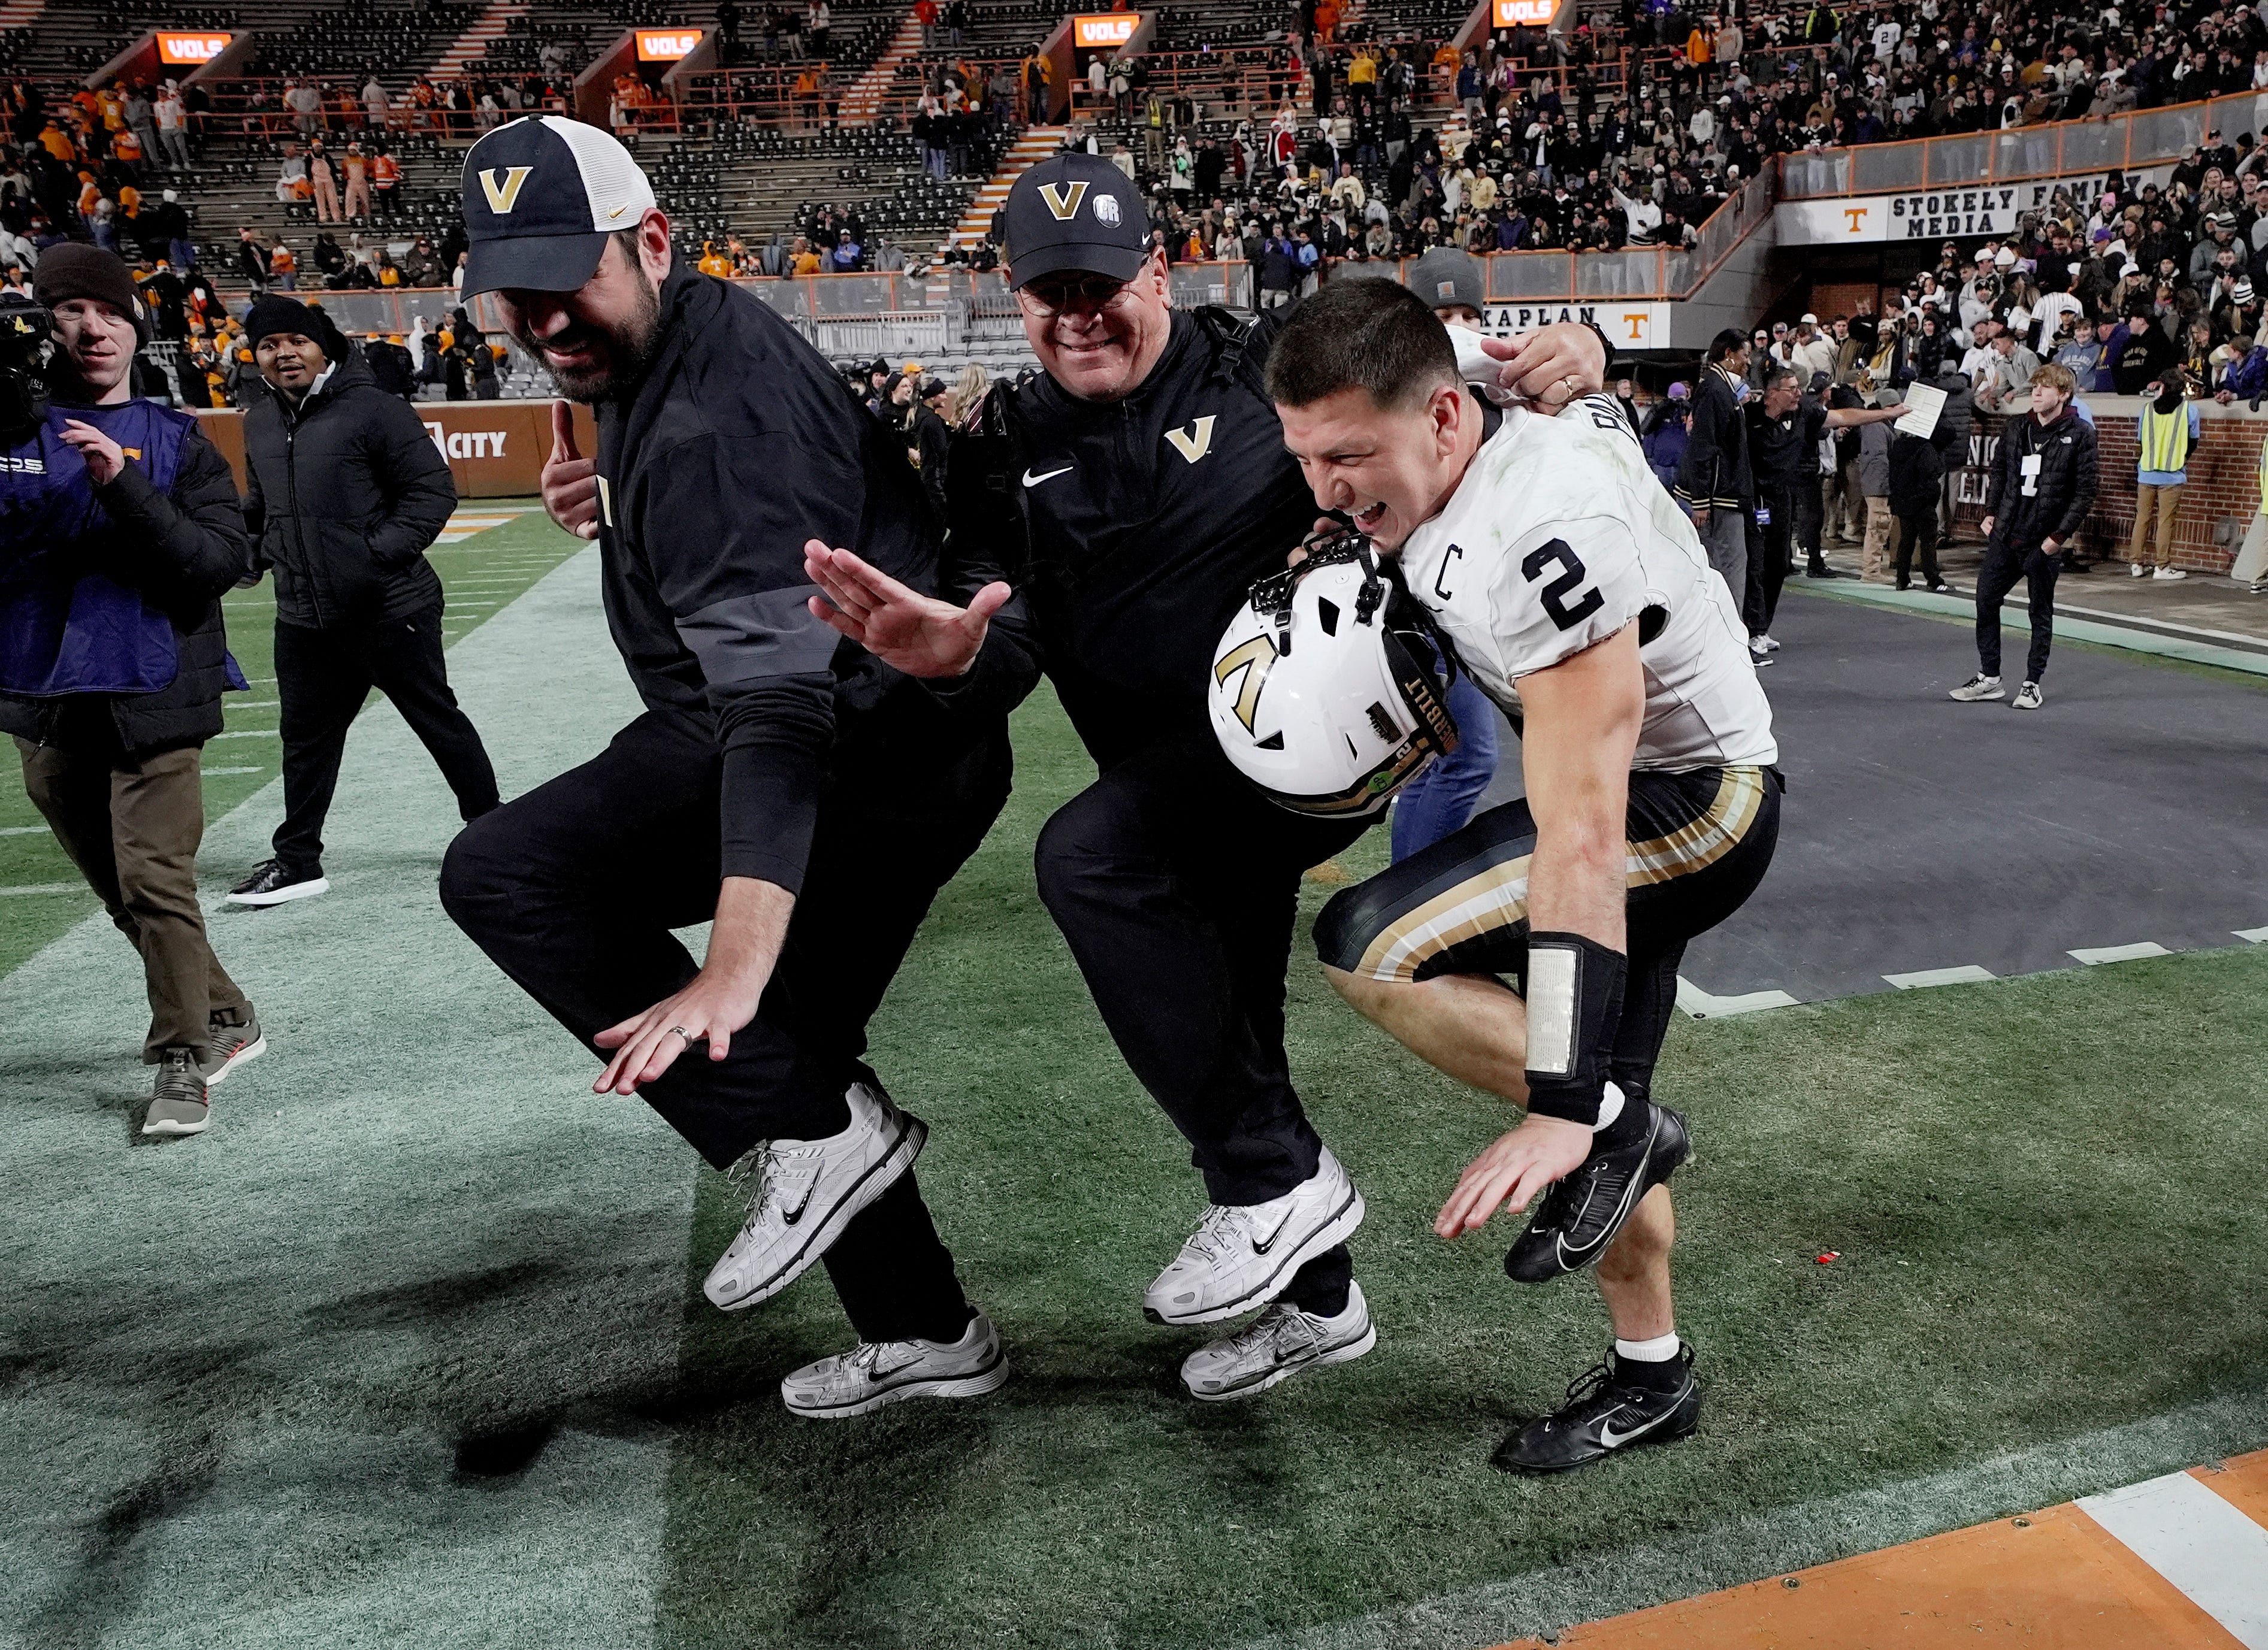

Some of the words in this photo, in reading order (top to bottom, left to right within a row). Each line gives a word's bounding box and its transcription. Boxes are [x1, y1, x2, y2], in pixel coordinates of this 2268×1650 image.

[1500, 0, 1552, 21] VOLS
[1082, 21, 1132, 41] VOLS
[1881, 32, 1889, 44] 2
[167, 40, 224, 58] VOLS
[645, 37, 695, 55] VOLS
[477, 166, 534, 214] V
[1037, 180, 1090, 220] V
[1892, 189, 2013, 217] STOKELY
[1844, 208, 1868, 232] T
[1907, 213, 1994, 238] MEDIA
[1480, 307, 1595, 328] KAPLAN
[1623, 314, 1648, 338] T
[447, 431, 507, 459] CITY
[1163, 414, 1217, 464] V
[1435, 543, 1463, 601] C
[1521, 537, 1605, 632] 2
[1396, 741, 1412, 759] 2
